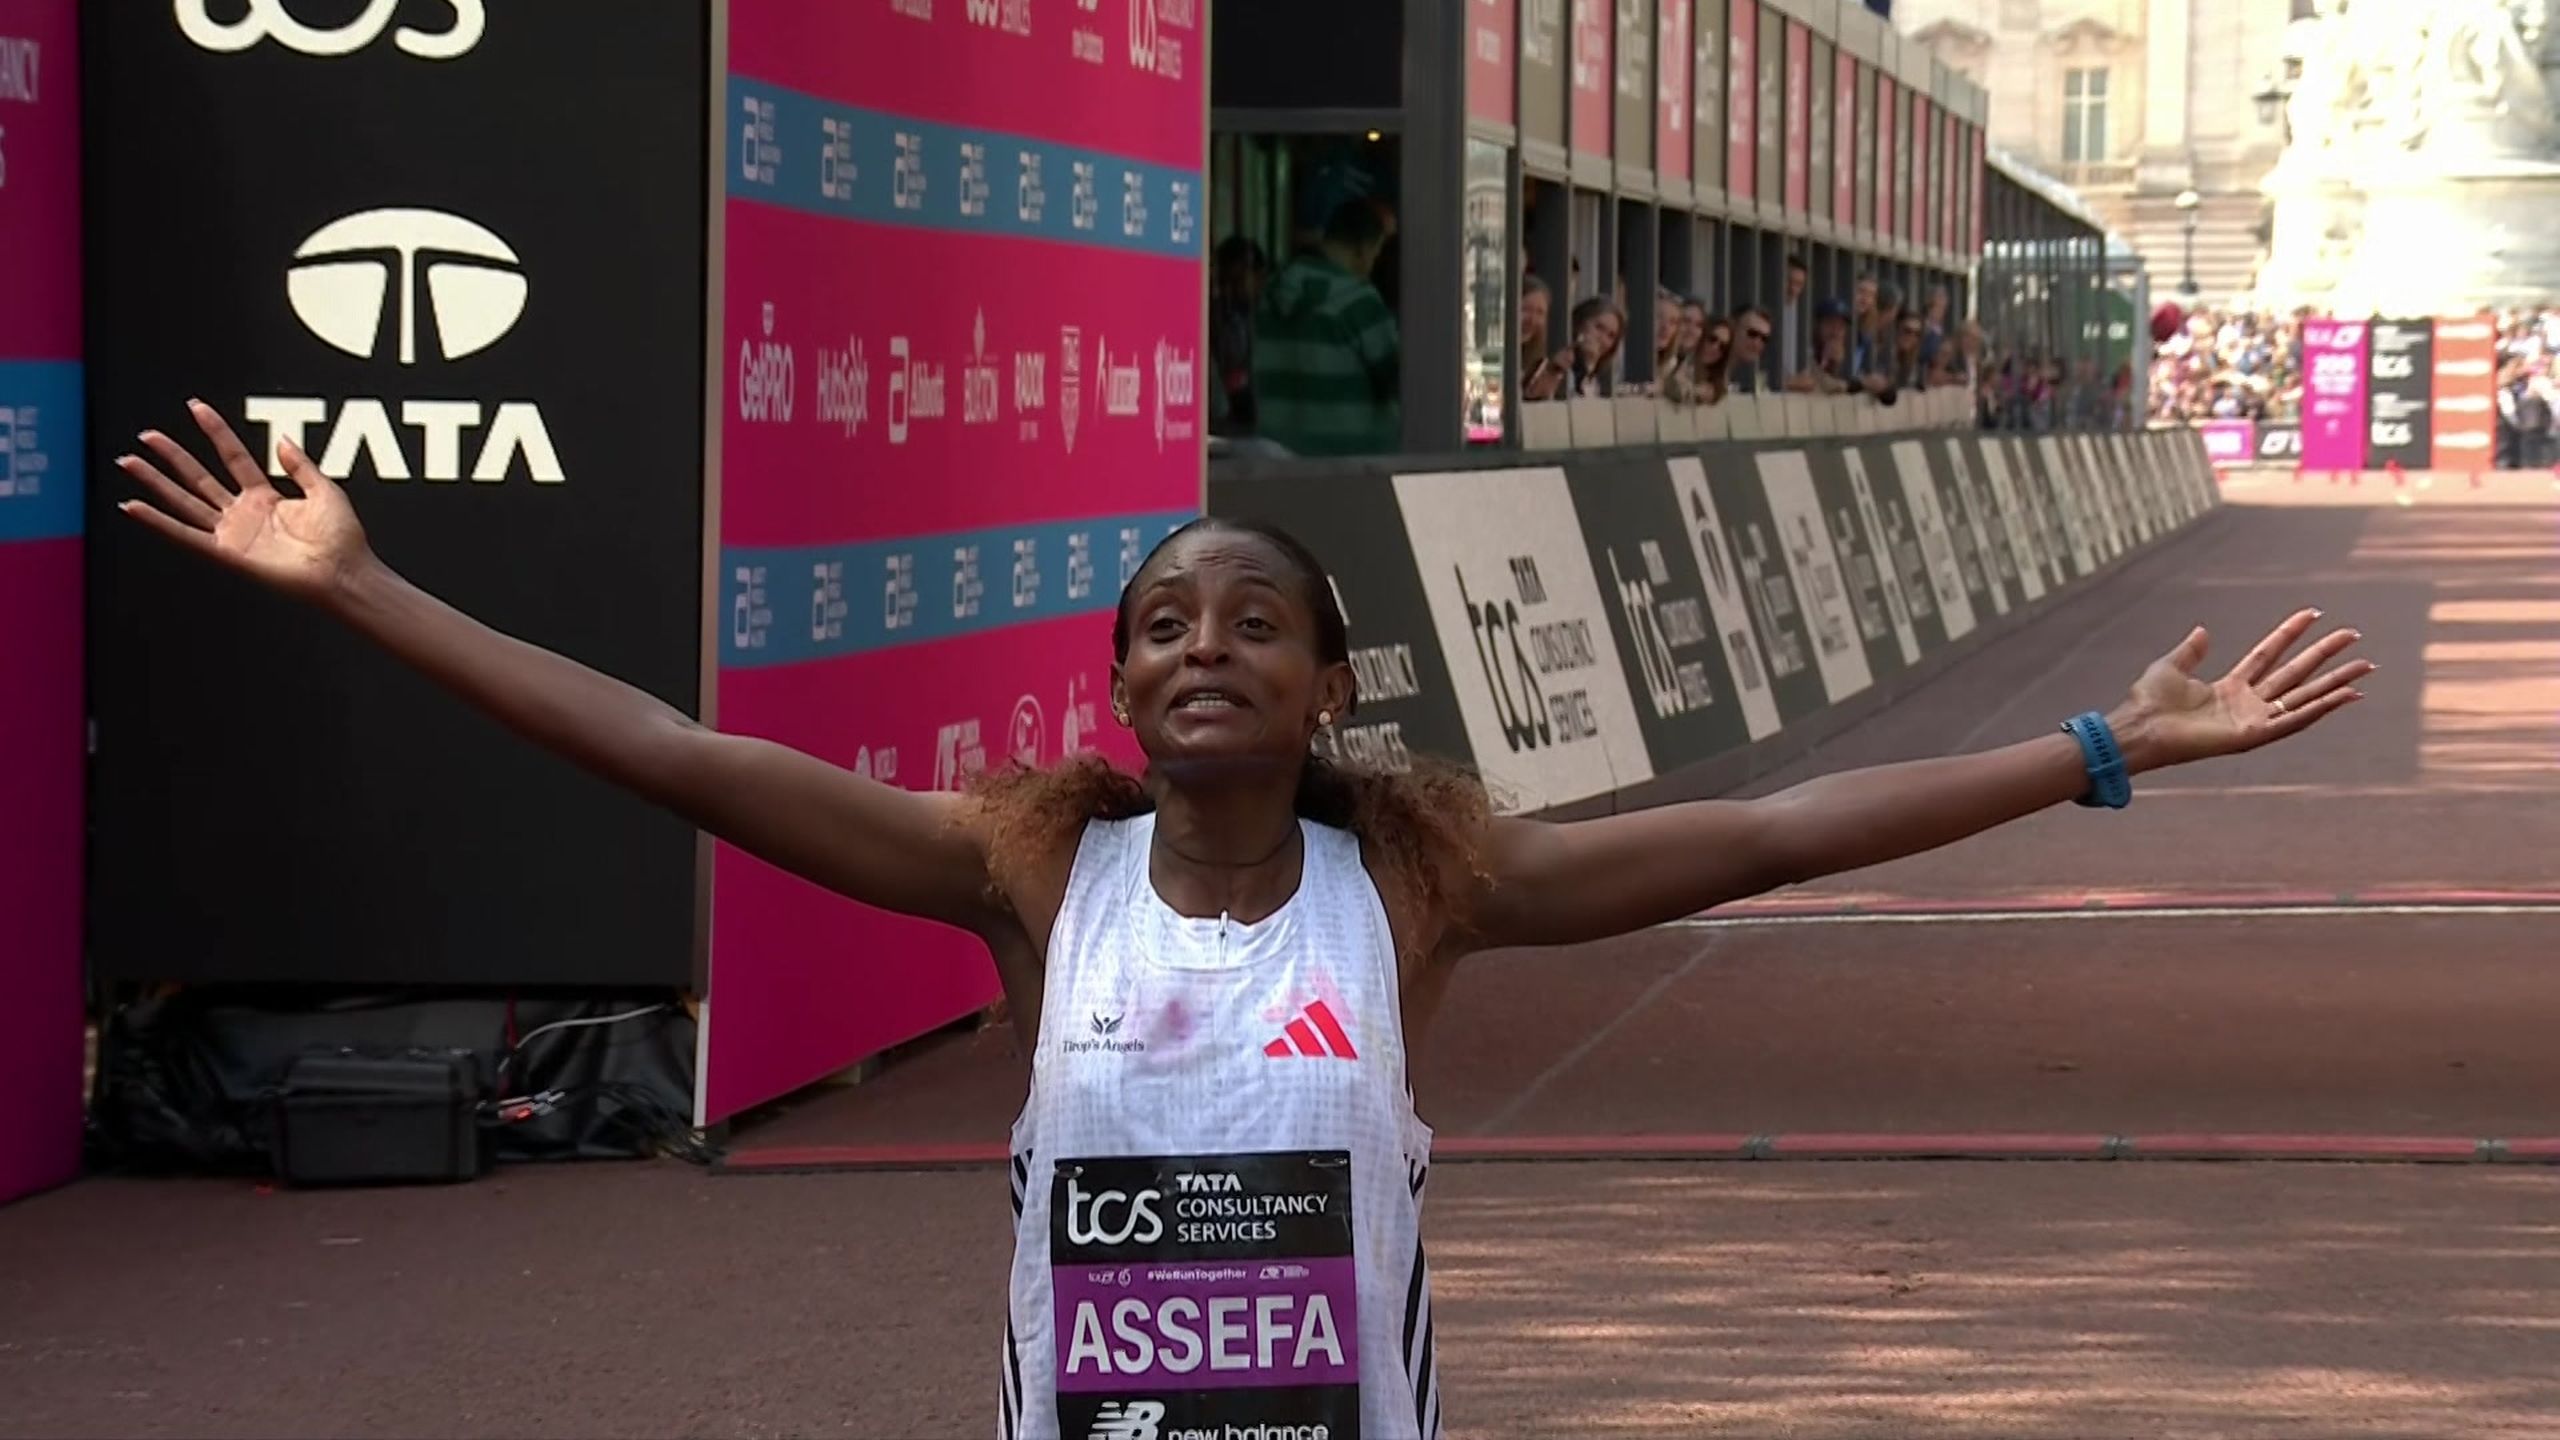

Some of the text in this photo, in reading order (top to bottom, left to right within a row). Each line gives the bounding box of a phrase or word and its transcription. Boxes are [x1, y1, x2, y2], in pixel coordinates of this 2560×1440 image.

[245, 396, 566, 482] TATA
[1454, 563, 1551, 753] tcs
[1102, 1038, 1145, 1056] Angels
[1175, 1173, 1243, 1193] TATA
[1067, 1178, 1164, 1246] tcs
[1175, 1194, 1329, 1219] CONSULTANCY
[1177, 1220, 1277, 1243] SERVICES
[1065, 1294, 1345, 1374] ASSEFA
[1225, 1423, 1329, 1440] balance
